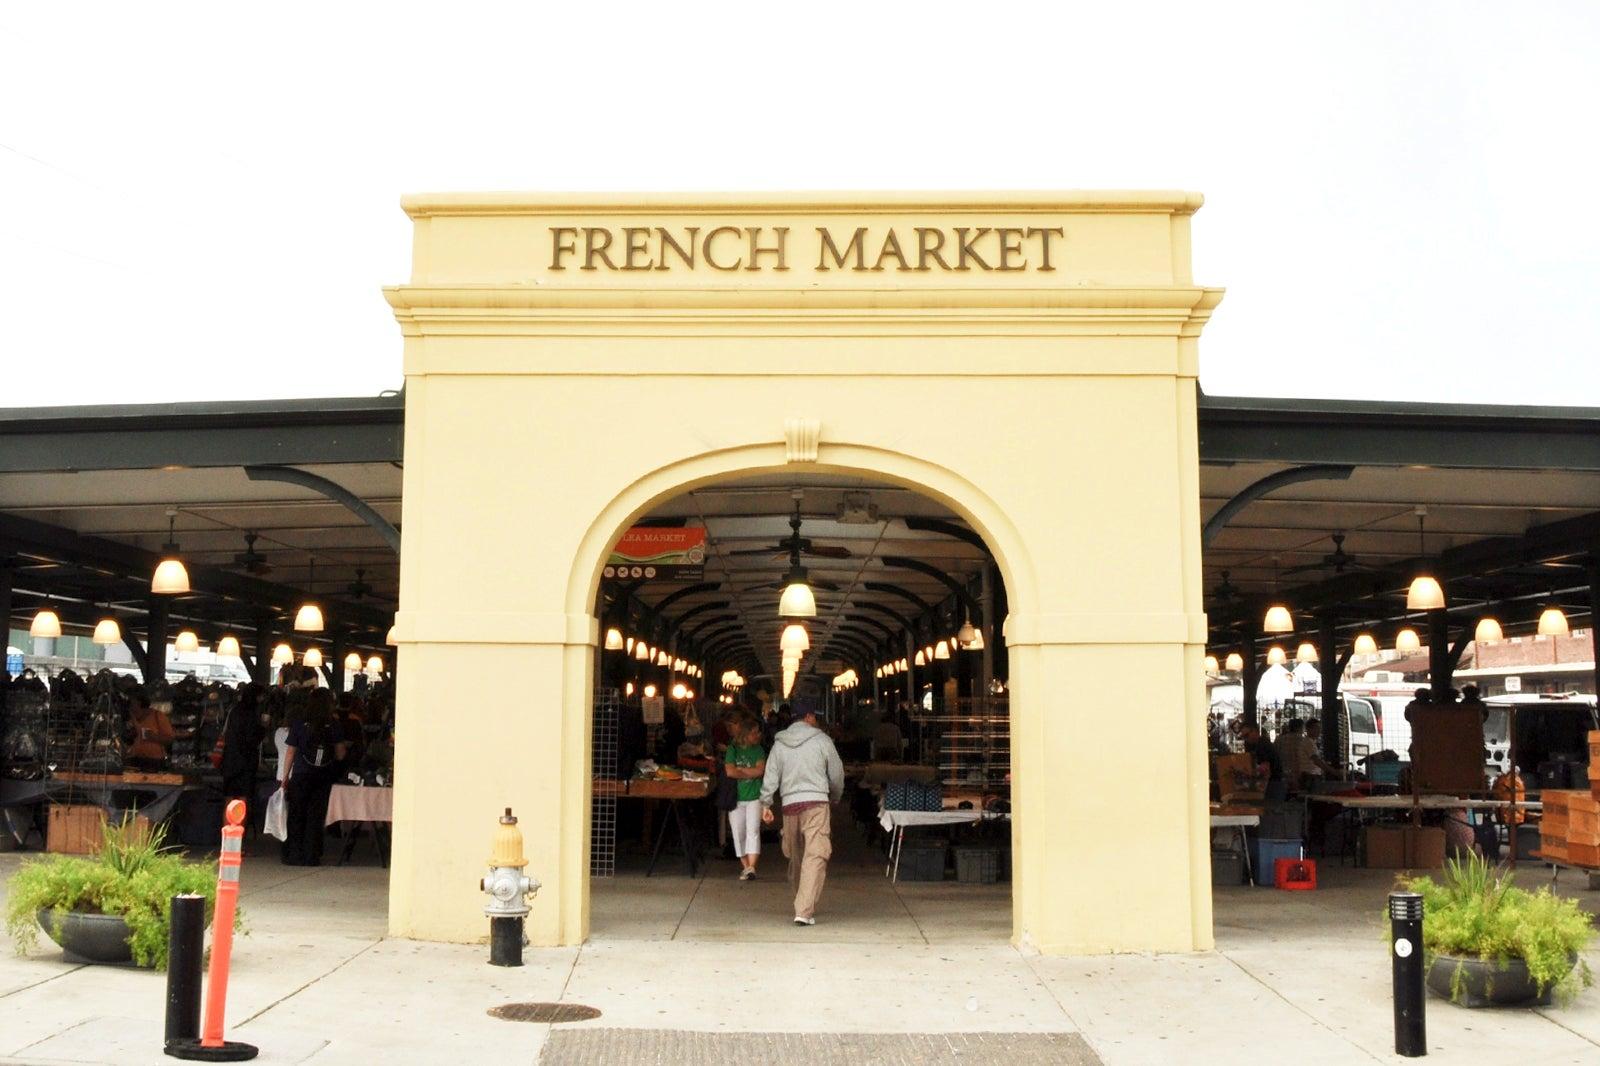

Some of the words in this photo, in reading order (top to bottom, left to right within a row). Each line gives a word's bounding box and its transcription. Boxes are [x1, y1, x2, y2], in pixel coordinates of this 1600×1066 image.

[548, 226, 790, 271] FRENCH
[814, 226, 1064, 271] MARKET
[622, 534, 641, 542] LEA
[644, 534, 686, 542] MARKET
